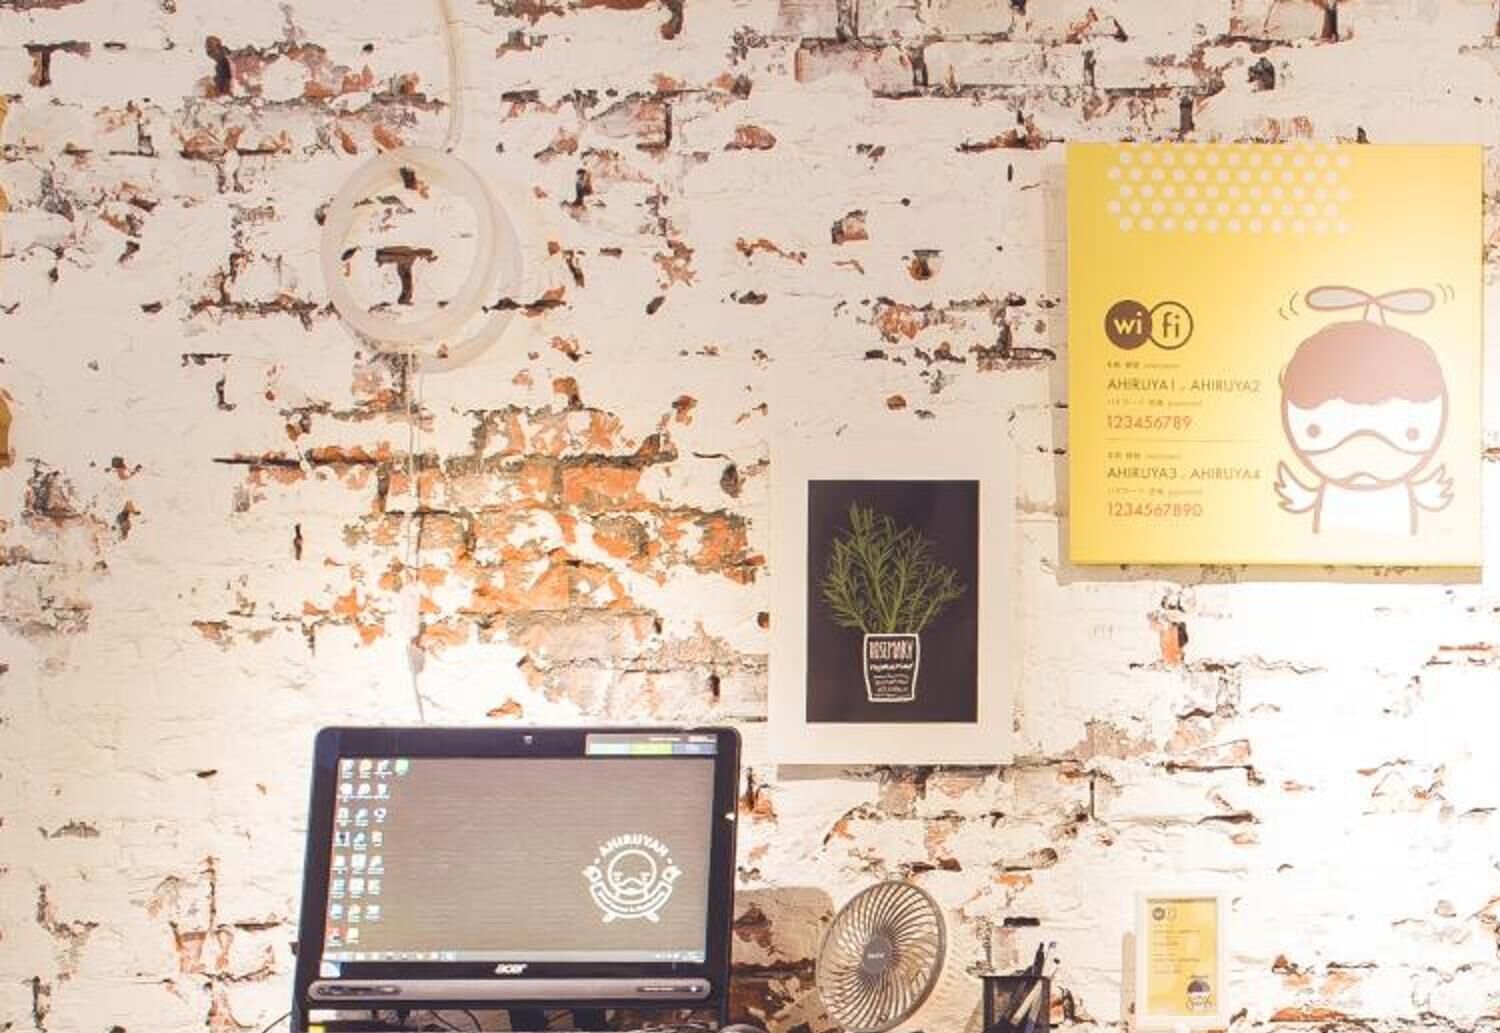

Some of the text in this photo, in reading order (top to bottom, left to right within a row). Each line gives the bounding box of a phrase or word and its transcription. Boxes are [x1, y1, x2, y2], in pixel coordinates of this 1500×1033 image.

[1113, 310, 1182, 339] wi fi
[1107, 377, 1263, 393] AHIRUYA1 AHIRUYA2
[1107, 414, 1193, 431] 123456789
[1107, 466, 1261, 481] AHIRUYA3 AHIRUYA4
[1107, 502, 1204, 518] 1234567890
